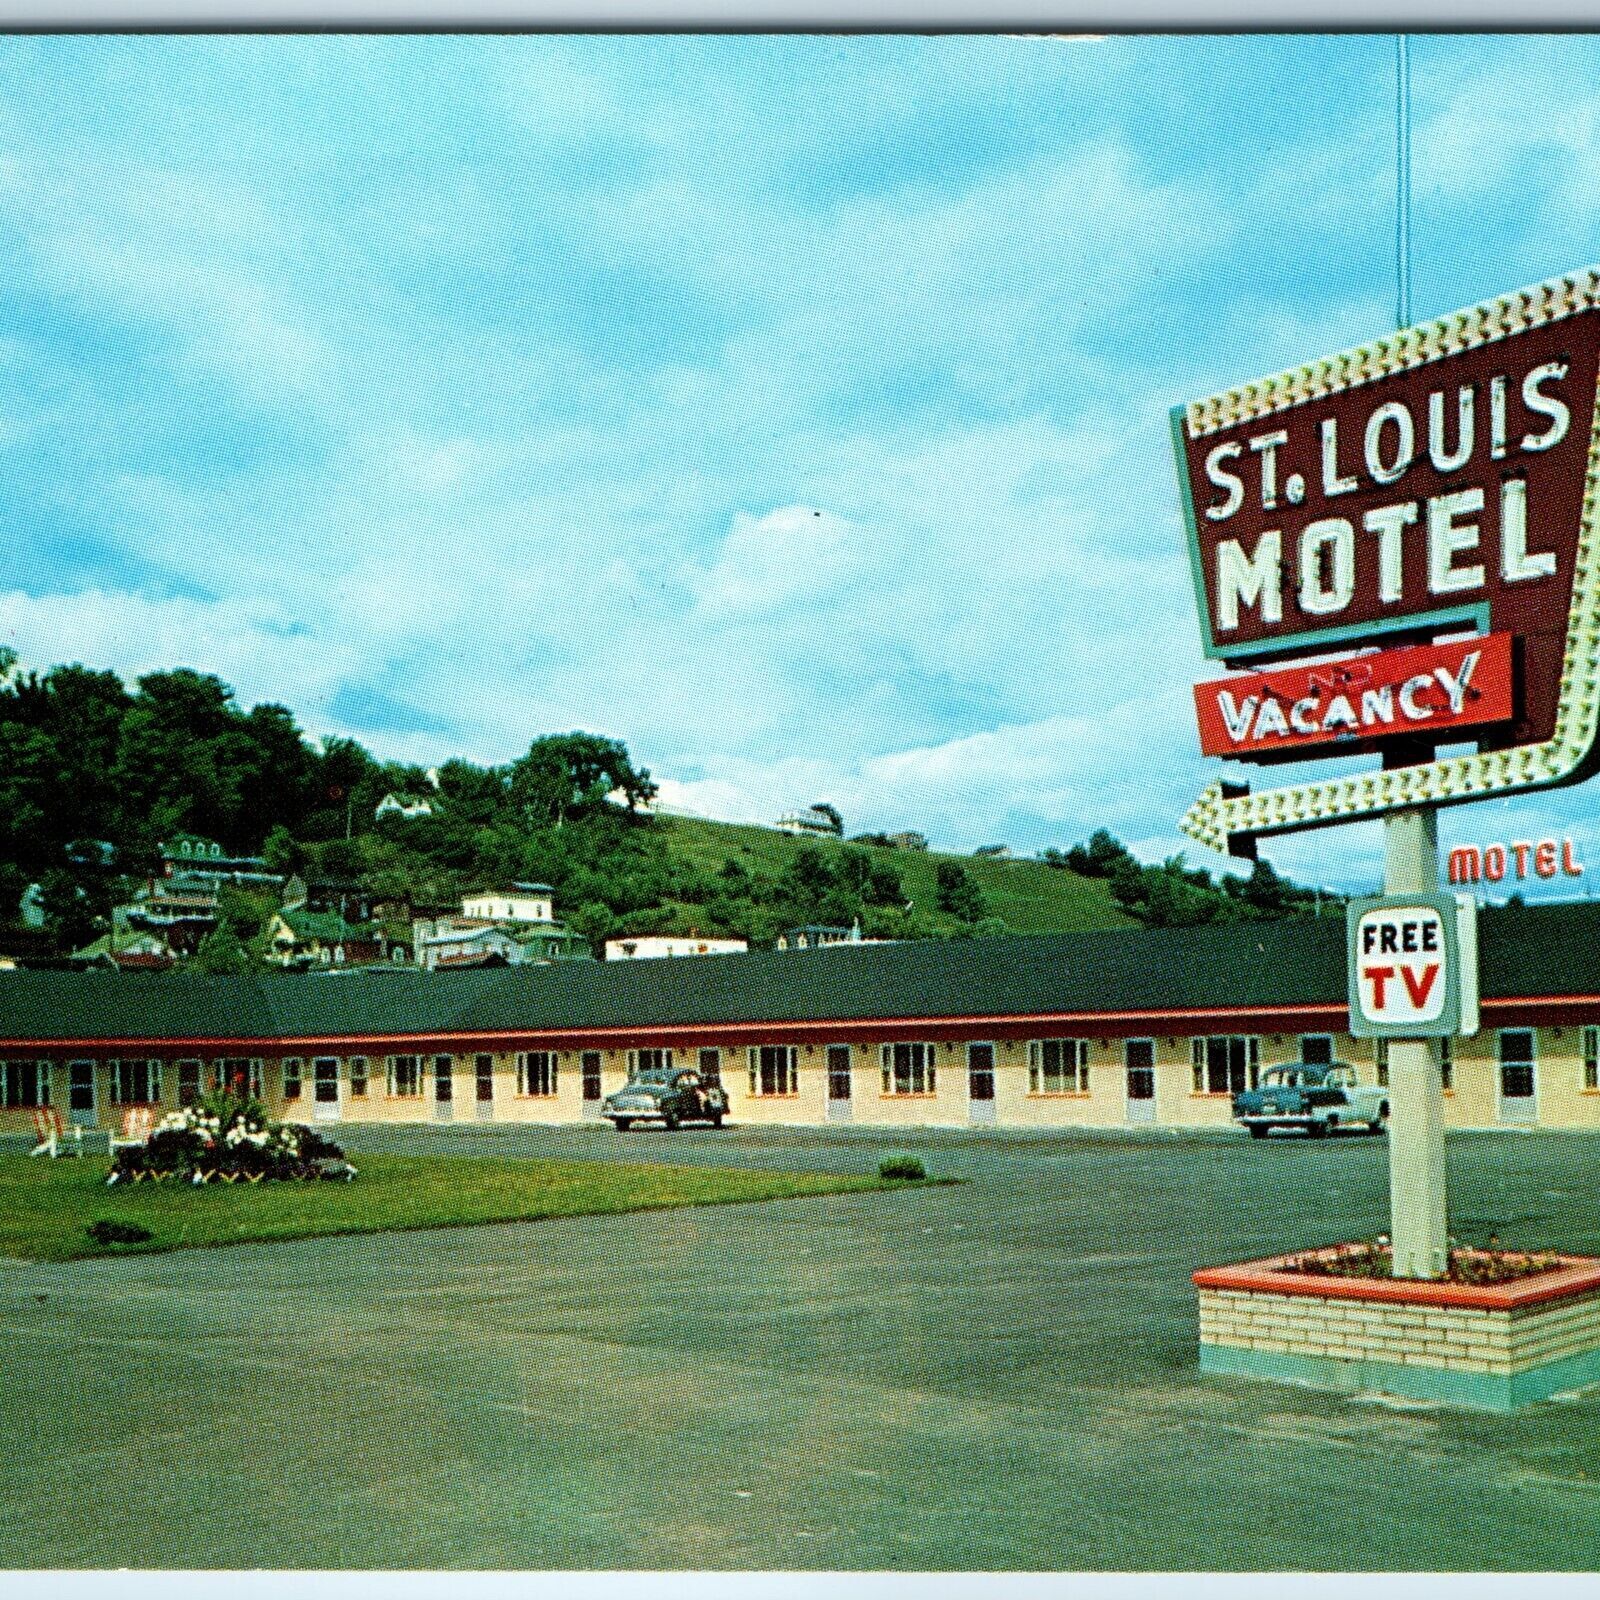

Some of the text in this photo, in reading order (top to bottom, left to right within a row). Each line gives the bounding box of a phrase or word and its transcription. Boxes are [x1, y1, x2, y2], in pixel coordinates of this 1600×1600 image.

[1204, 361, 1572, 521] ST. LOUIS
[1215, 478, 1558, 632] MOTEL
[1217, 650, 1482, 743] VACANCY
[1447, 837, 1584, 884] MOTEL
[1362, 919, 1440, 955] FREE
[1362, 963, 1440, 1011] TV
